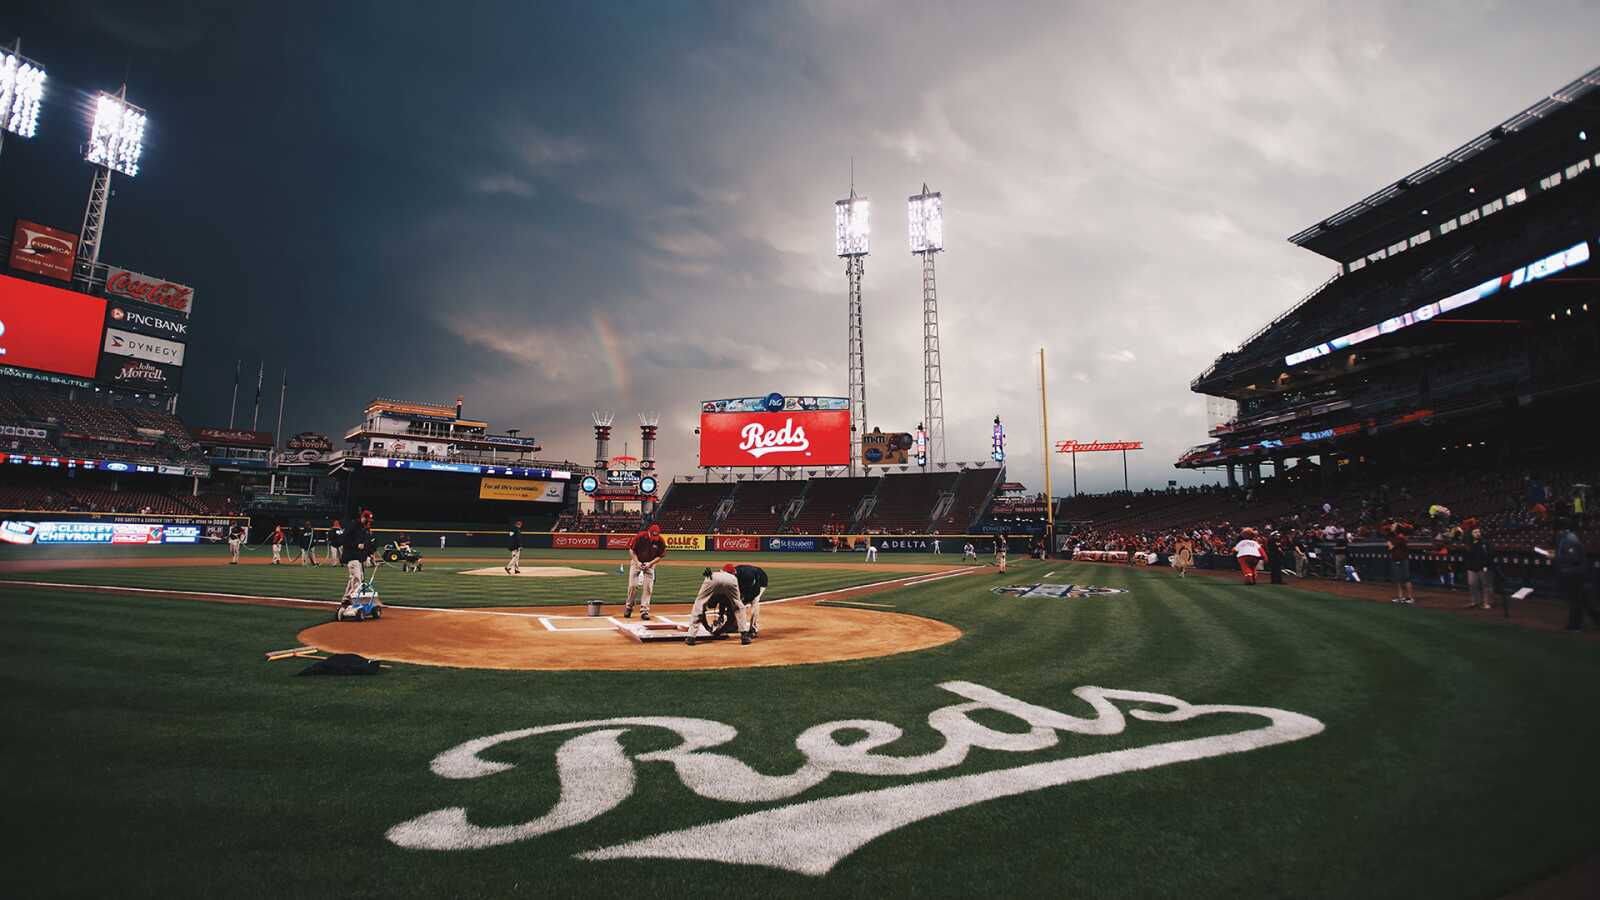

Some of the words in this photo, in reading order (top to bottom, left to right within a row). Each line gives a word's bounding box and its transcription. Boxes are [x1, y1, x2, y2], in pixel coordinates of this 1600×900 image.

[106, 271, 192, 310] Coca-Cola
[128, 340, 178, 357] DYNEGY
[137, 362, 156, 372] John
[115, 366, 167, 381] Morrell
[50, 376, 90, 388] SHUTTLE
[739, 418, 810, 458] Reds
[301, 440, 328, 449] TOYOTA
[39, 532, 112, 541] CHEVROLET
[667, 536, 699, 546] OLLIE'S
[892, 540, 927, 548] DELTA
[382, 679, 1327, 876] Reds
